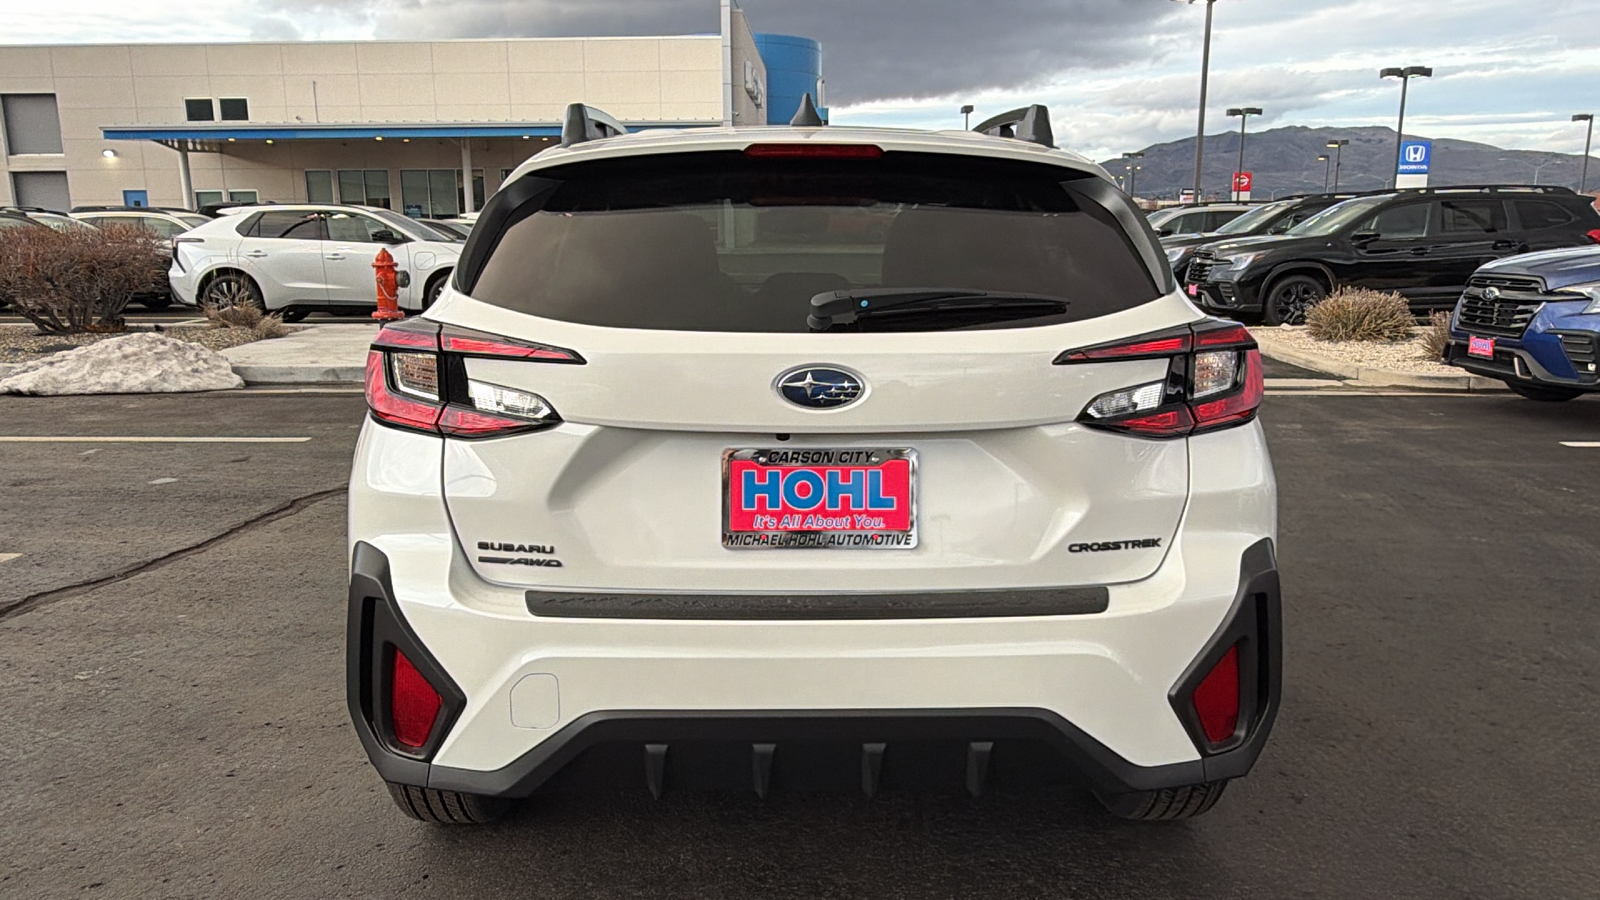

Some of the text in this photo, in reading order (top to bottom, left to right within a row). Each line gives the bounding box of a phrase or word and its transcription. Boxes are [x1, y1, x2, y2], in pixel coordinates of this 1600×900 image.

[768, 451, 875, 464] CARSON CITY
[742, 469, 896, 510] HOHL
[753, 514, 885, 528] It's All About You.
[726, 533, 913, 546] MICHAEL HOHL AUTOMOTIVE
[1067, 537, 1162, 553] CROSSTREK
[477, 541, 555, 554] SUBARU
[508, 557, 563, 568] AWD
